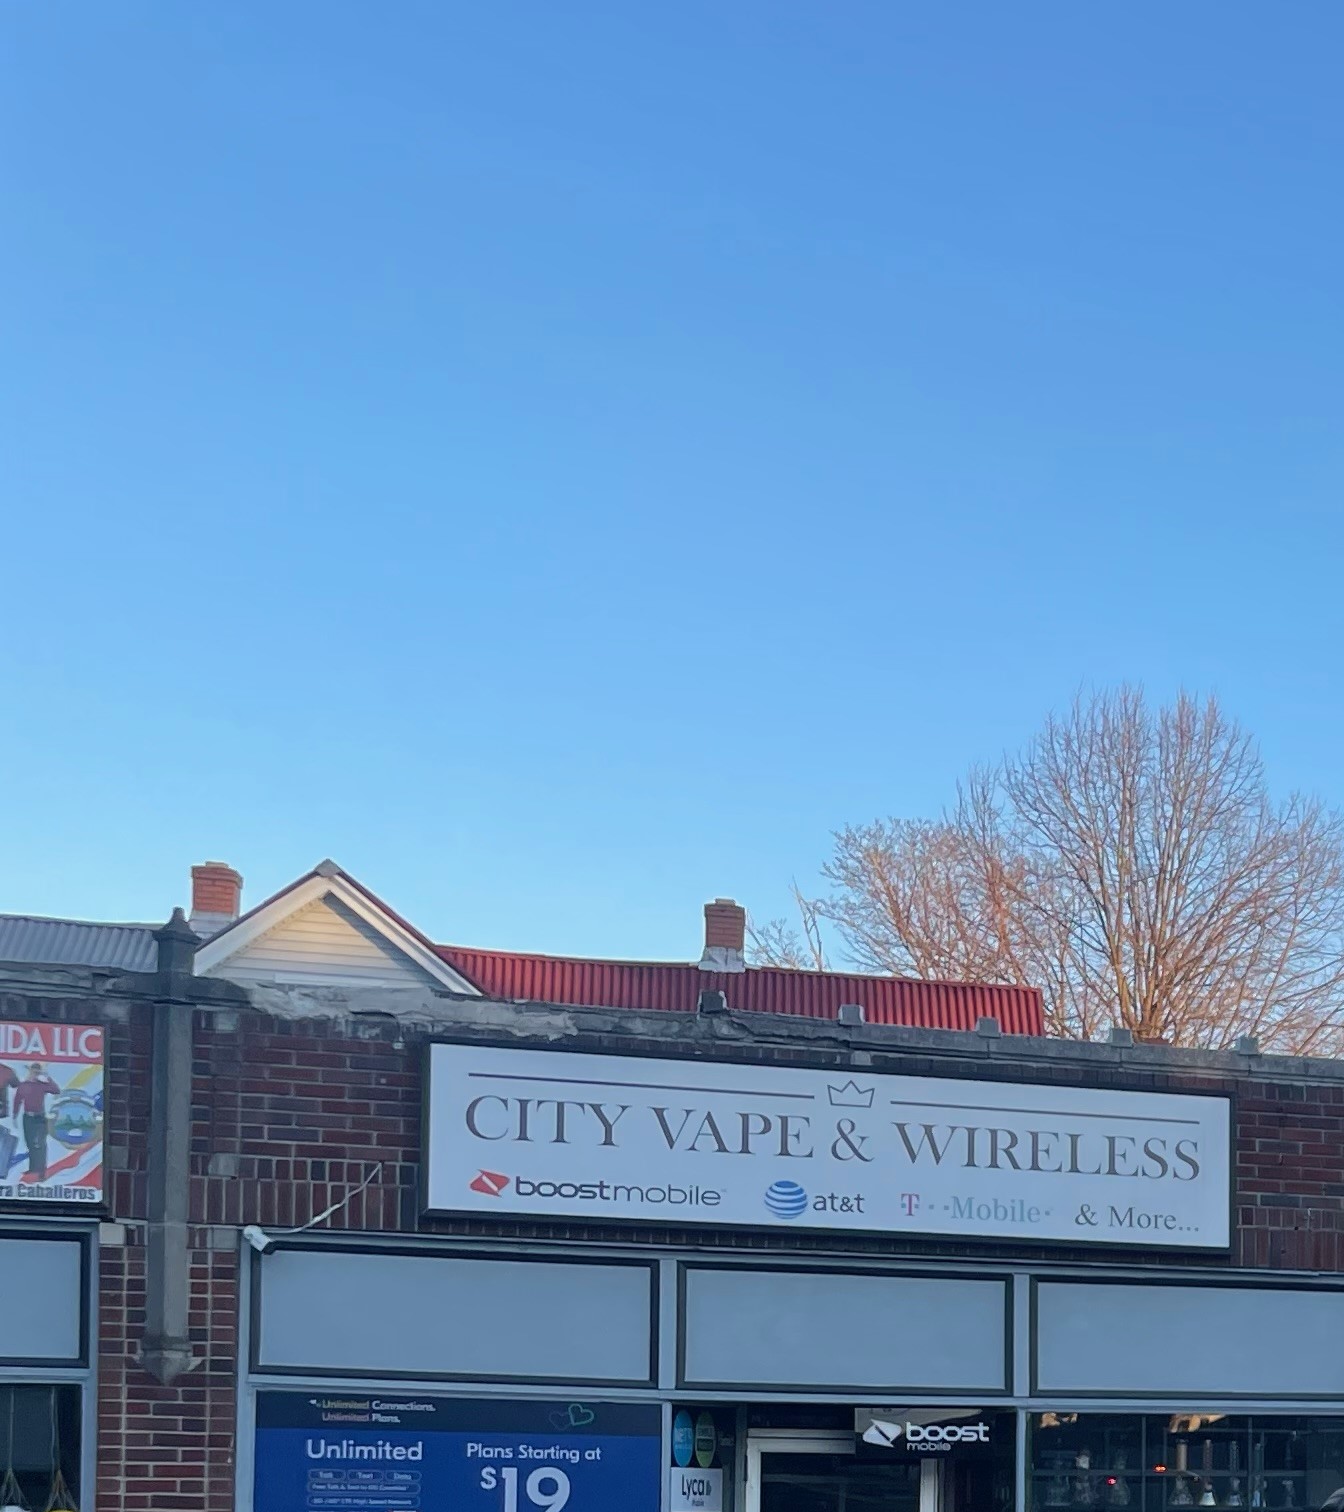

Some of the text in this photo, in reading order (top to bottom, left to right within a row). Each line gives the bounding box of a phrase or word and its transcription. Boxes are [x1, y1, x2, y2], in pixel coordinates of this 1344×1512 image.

[53, 1026, 102, 1058] LLC
[465, 1095, 1201, 1182] CITY VAPE & WIRELESS
[17, 1183, 96, 1201] Caballeros
[812, 1191, 865, 1214] at&t
[1075, 1204, 1201, 1232] & More...
[905, 1421, 990, 1442] boost
[307, 1438, 423, 1461] Unlimited
[467, 1442, 602, 1464] Plans Starting at
[906, 1442, 952, 1452] mobile
[681, 1474, 705, 1500] Lyca
